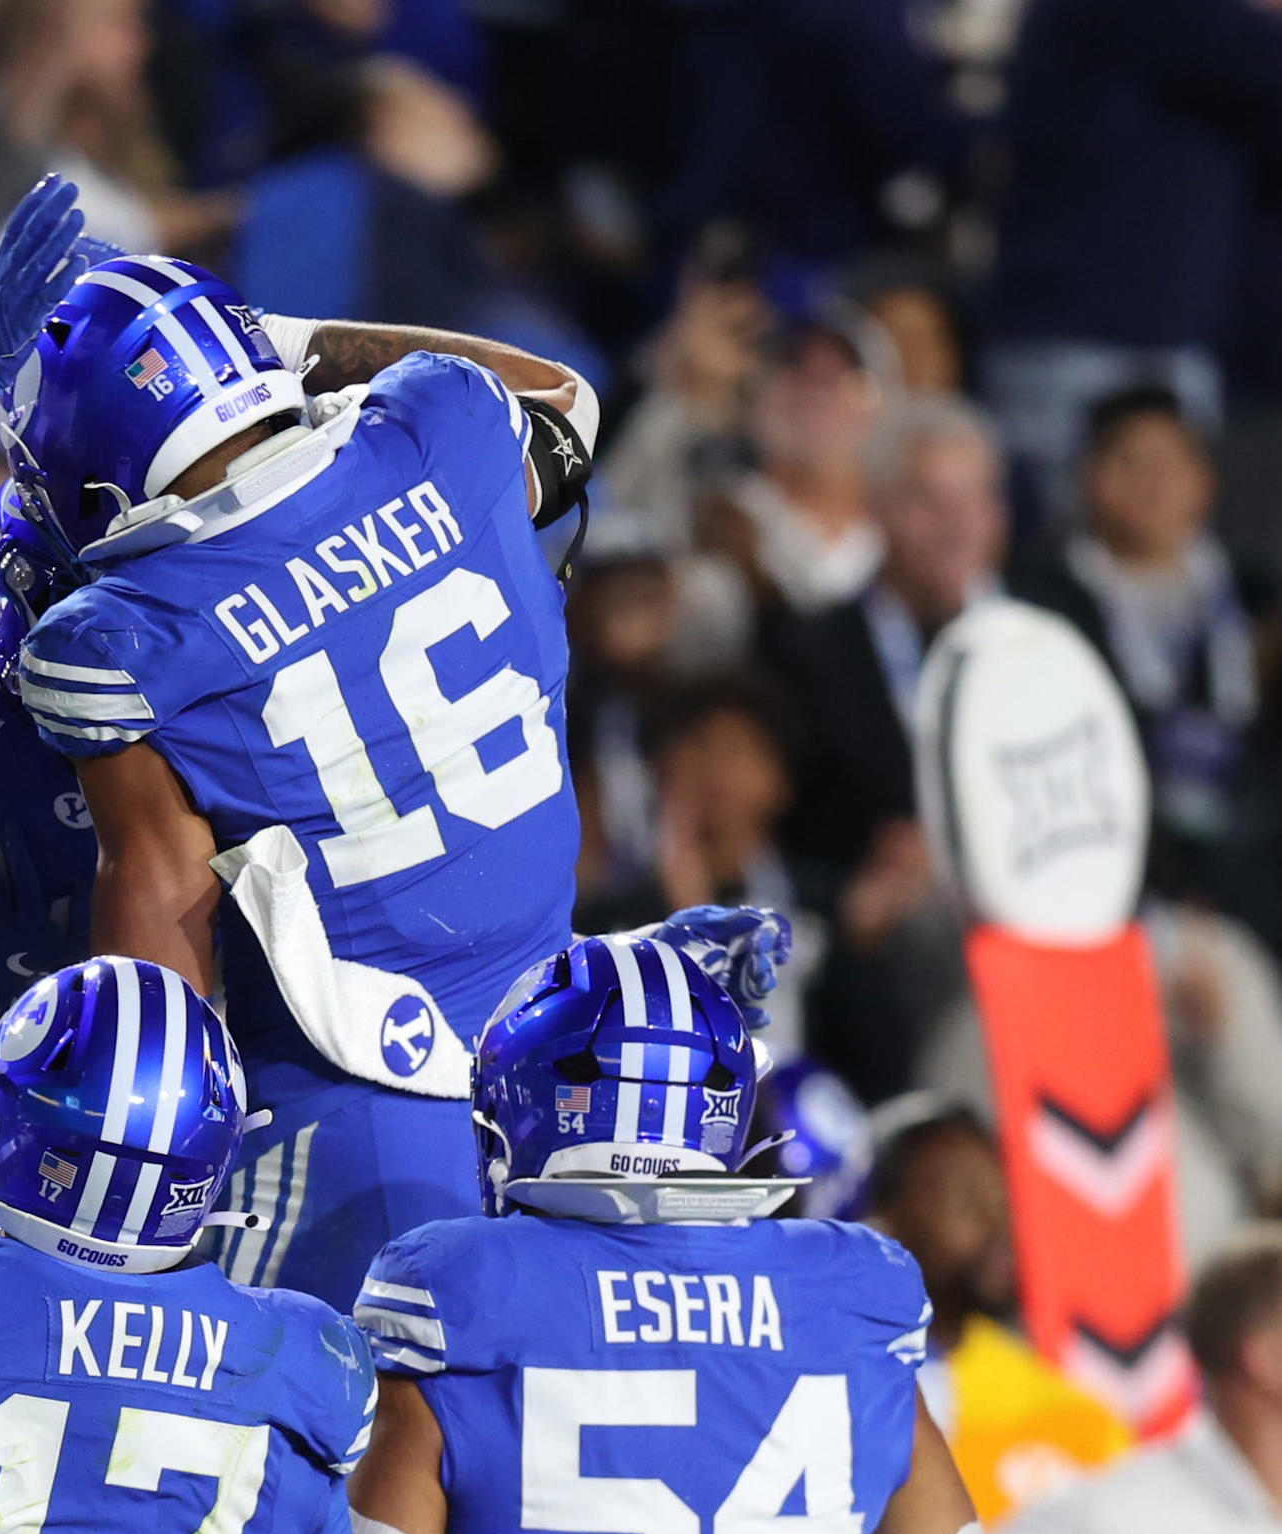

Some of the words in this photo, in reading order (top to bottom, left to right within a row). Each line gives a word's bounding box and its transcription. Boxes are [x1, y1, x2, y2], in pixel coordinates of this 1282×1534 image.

[147, 374, 175, 402] 16
[214, 481, 464, 664] GLASKER
[260, 567, 564, 889] 16
[382, 1006, 433, 1072] Y
[703, 1089, 739, 1123] XII
[557, 1112, 586, 1136] 54
[610, 1153, 630, 1173] GO
[633, 1157, 681, 1174] COUGS
[38, 1178, 64, 1203] 17
[166, 1179, 213, 1213] XII
[56, 1237, 79, 1258] GO
[80, 1247, 129, 1268] COUGS
[596, 1269, 785, 1352] ESERA
[58, 1297, 229, 1391] KELLY
